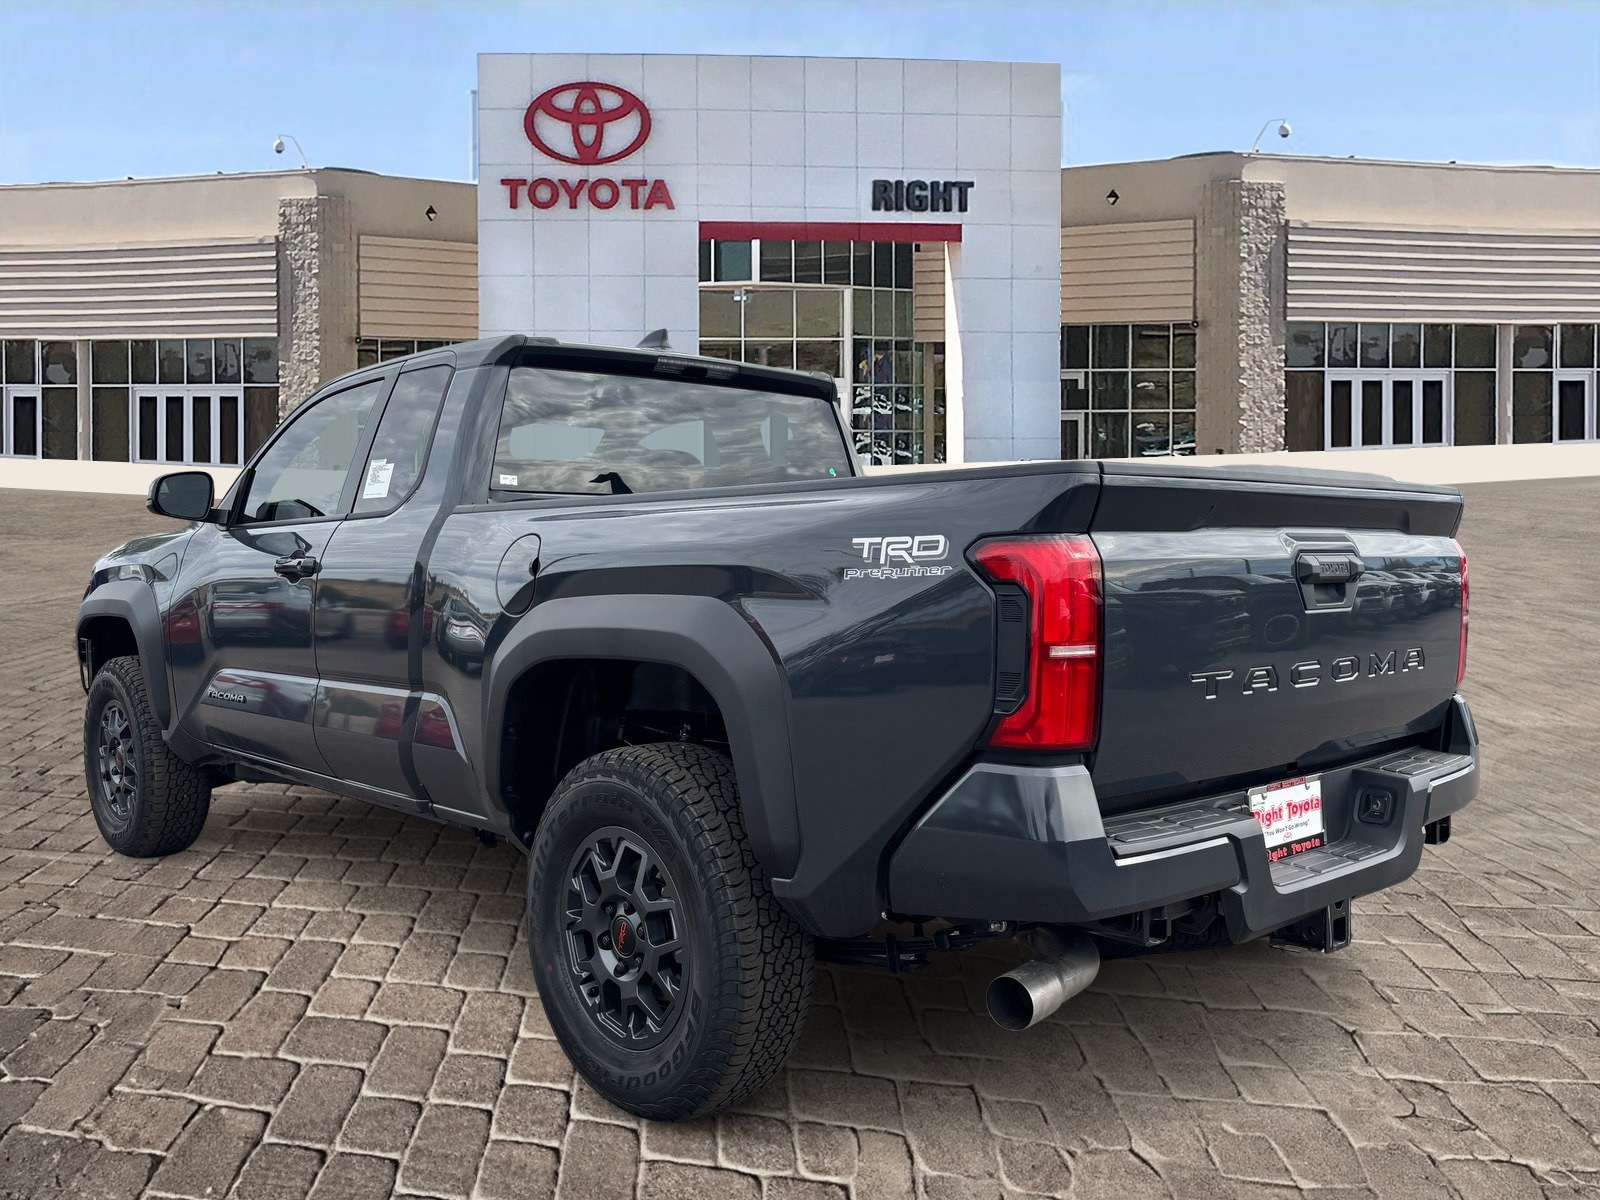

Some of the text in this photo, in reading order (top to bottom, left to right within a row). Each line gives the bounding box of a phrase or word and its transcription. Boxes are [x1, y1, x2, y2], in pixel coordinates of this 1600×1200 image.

[501, 178, 675, 210] TOYOTA
[872, 180, 975, 213] RIGHT
[851, 534, 949, 567] TRD
[1320, 563, 1349, 575] TOYOTA
[1189, 647, 1426, 700] TACOMA
[207, 690, 245, 703] TACOMA
[1286, 796, 1321, 820] Toyota
[1267, 838, 1321, 861] ight Toyota
[618, 921, 627, 950] TRD
[572, 989, 702, 1091] BFGoodrich
